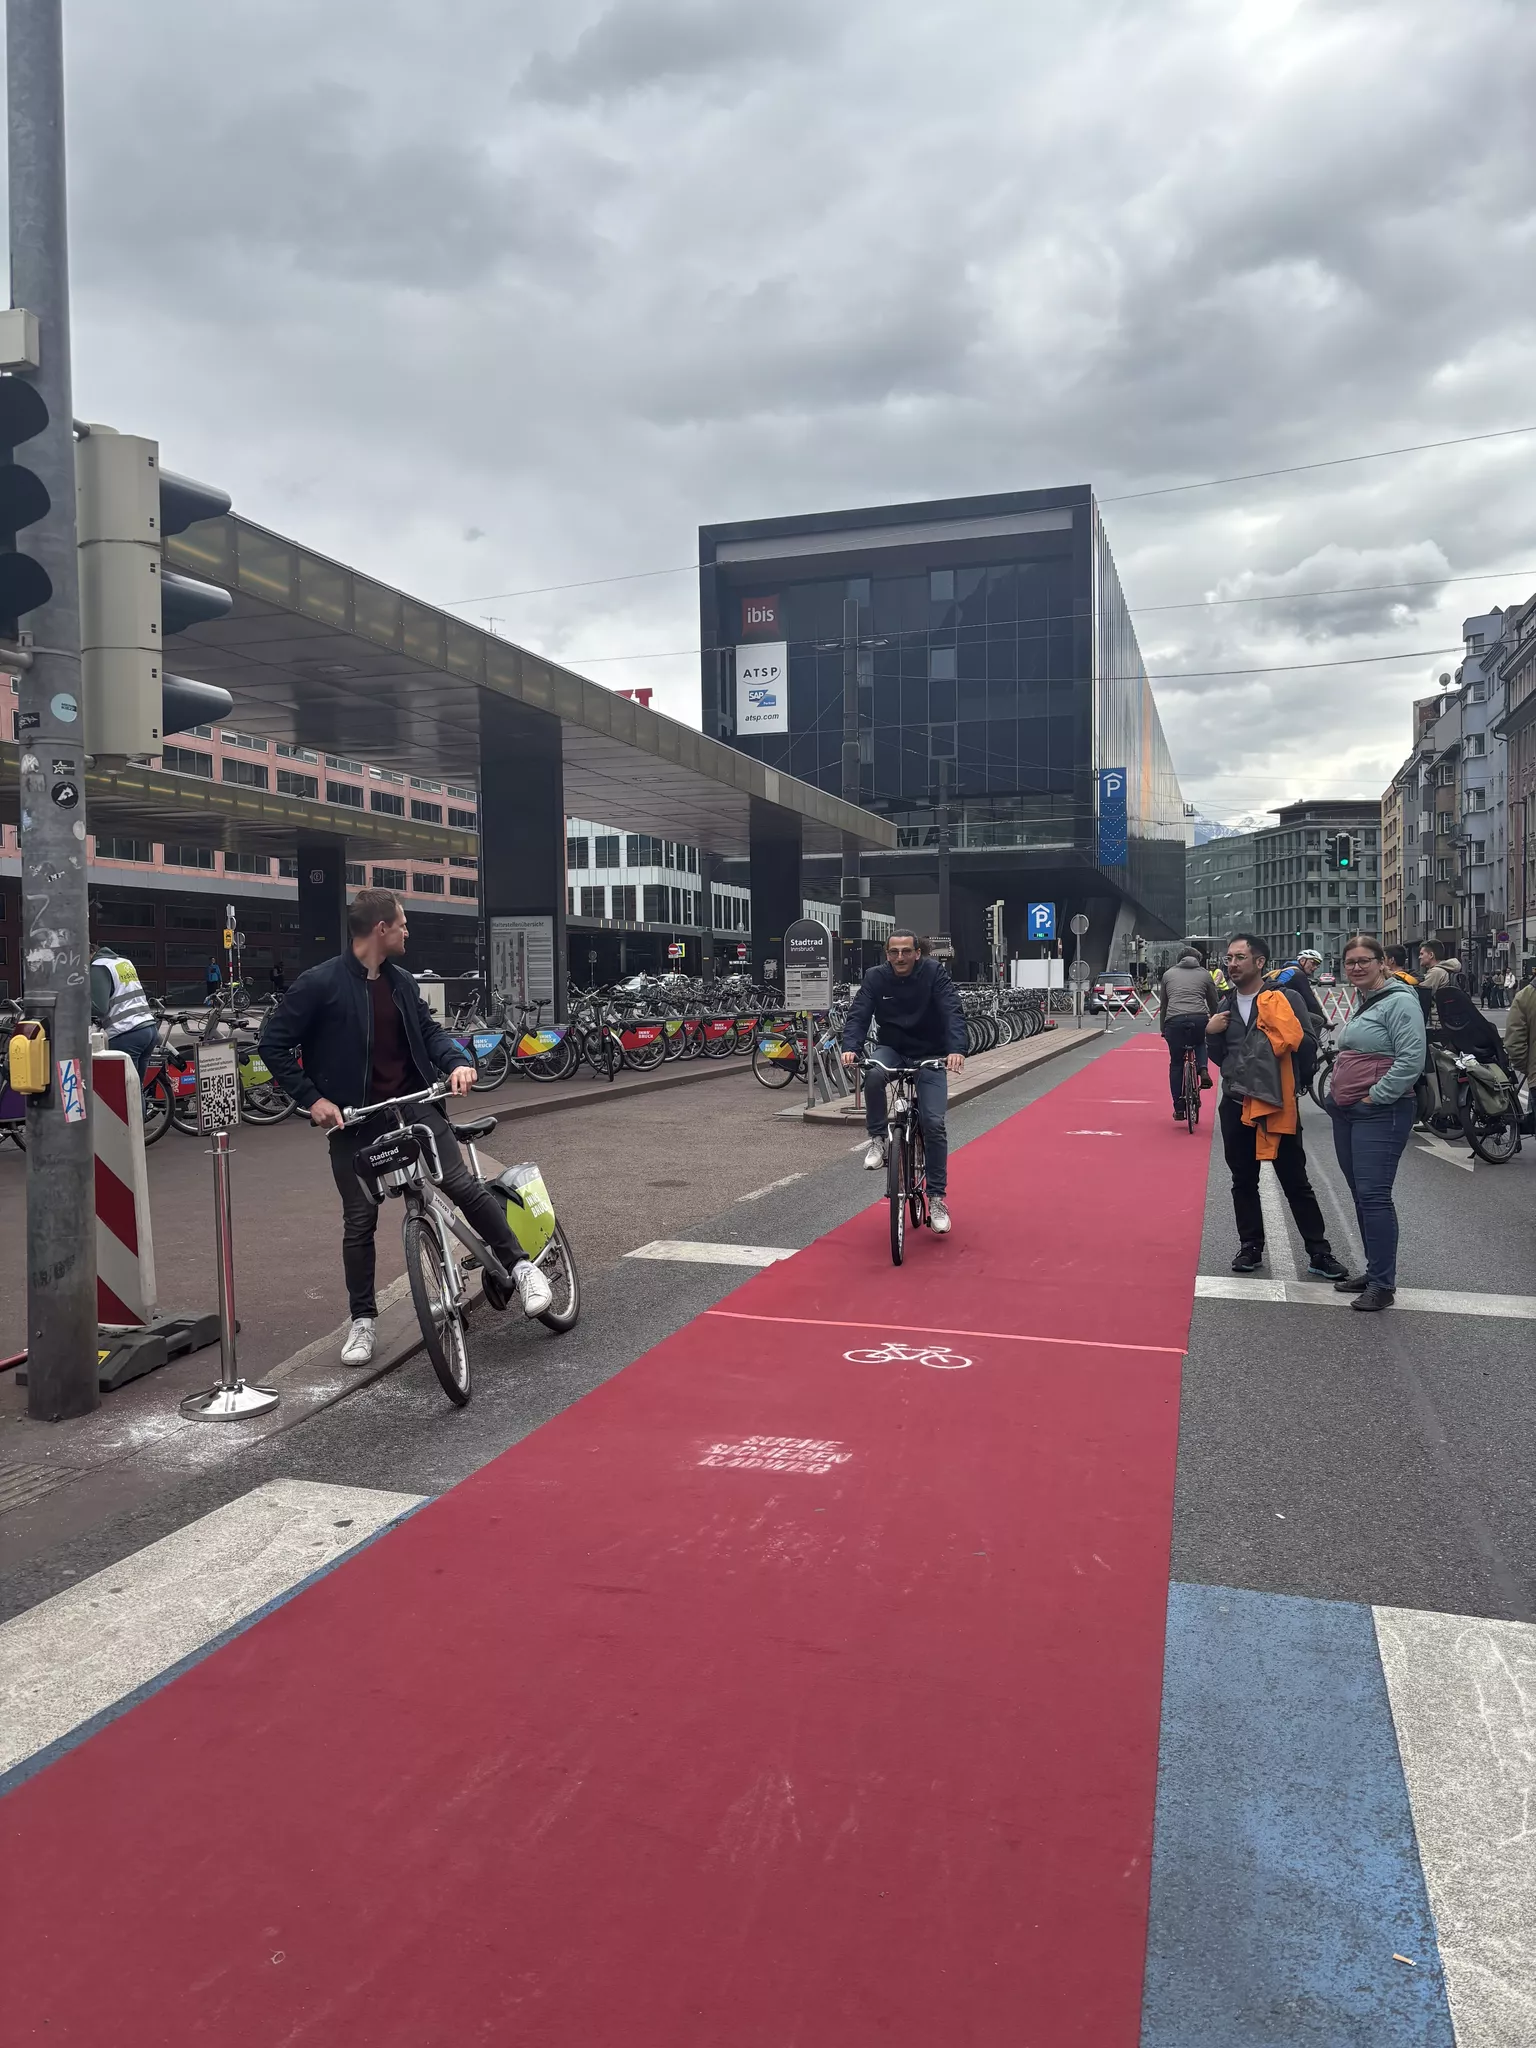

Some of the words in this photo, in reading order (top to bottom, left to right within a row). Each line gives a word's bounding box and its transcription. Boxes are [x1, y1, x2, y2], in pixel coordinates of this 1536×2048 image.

[747, 606, 775, 623] ibis
[743, 667, 778, 679] ATSP
[749, 692, 763, 700] SAP
[745, 712, 779, 722] atsp.com
[1107, 779, 1120, 797] P
[1036, 911, 1048, 928] P
[790, 938, 823, 946] Stadtrad
[369, 1146, 399, 1162] Stadtrad
[371, 1156, 393, 1167] Innsbruck
[742, 1435, 844, 1450] SUCHE
[711, 1443, 853, 1463] SICHEREN
[697, 1455, 832, 1474] RADWEG
